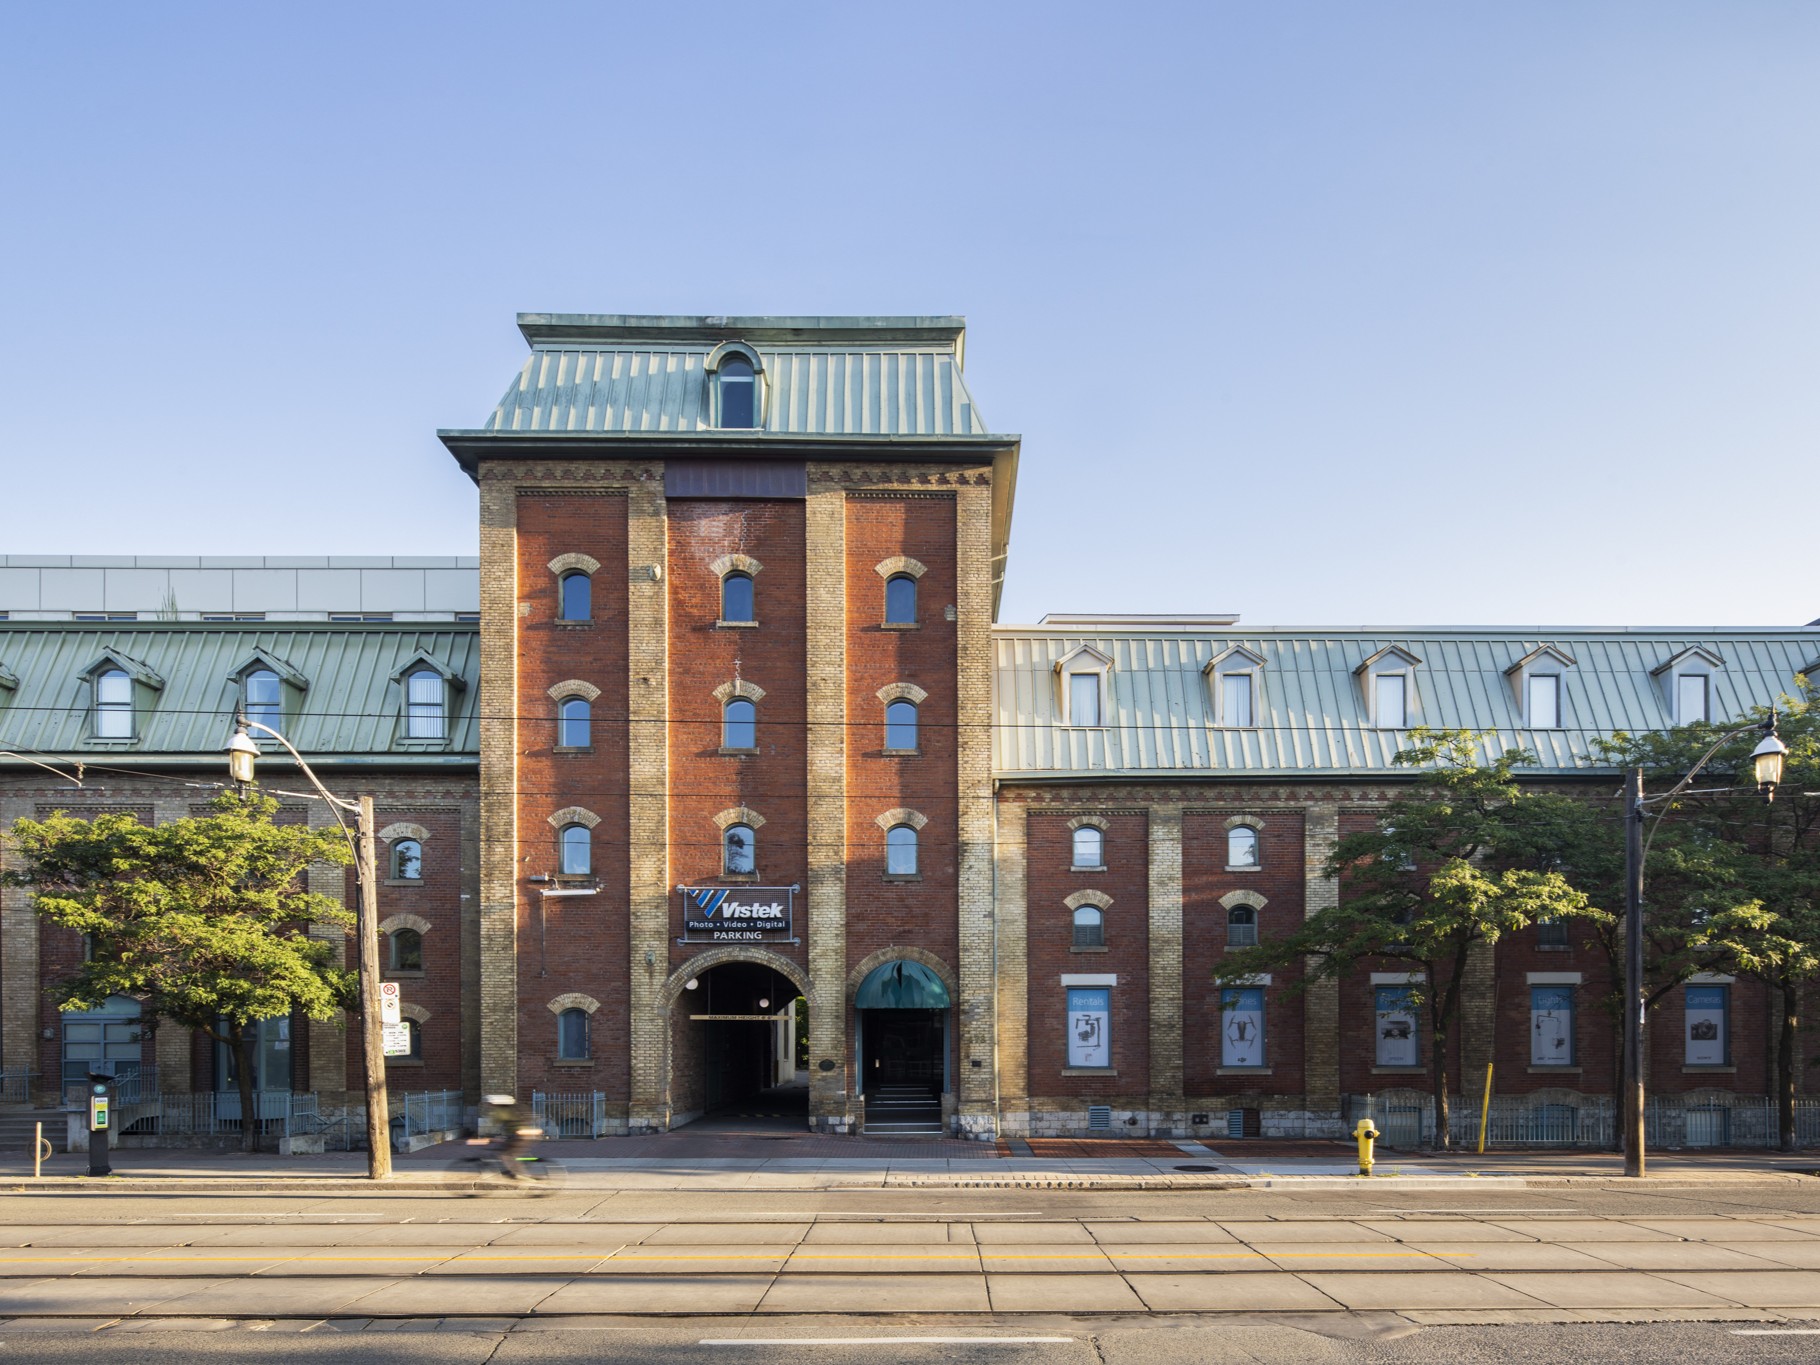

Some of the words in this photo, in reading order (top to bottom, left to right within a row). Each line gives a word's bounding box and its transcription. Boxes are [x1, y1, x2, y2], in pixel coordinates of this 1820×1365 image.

[722, 902, 784, 918] Vistek
[756, 921, 786, 929] Digital
[714, 931, 762, 939] PARKING
[1072, 996, 1104, 1006] Rentals
[1687, 994, 1721, 1004] Cameras
